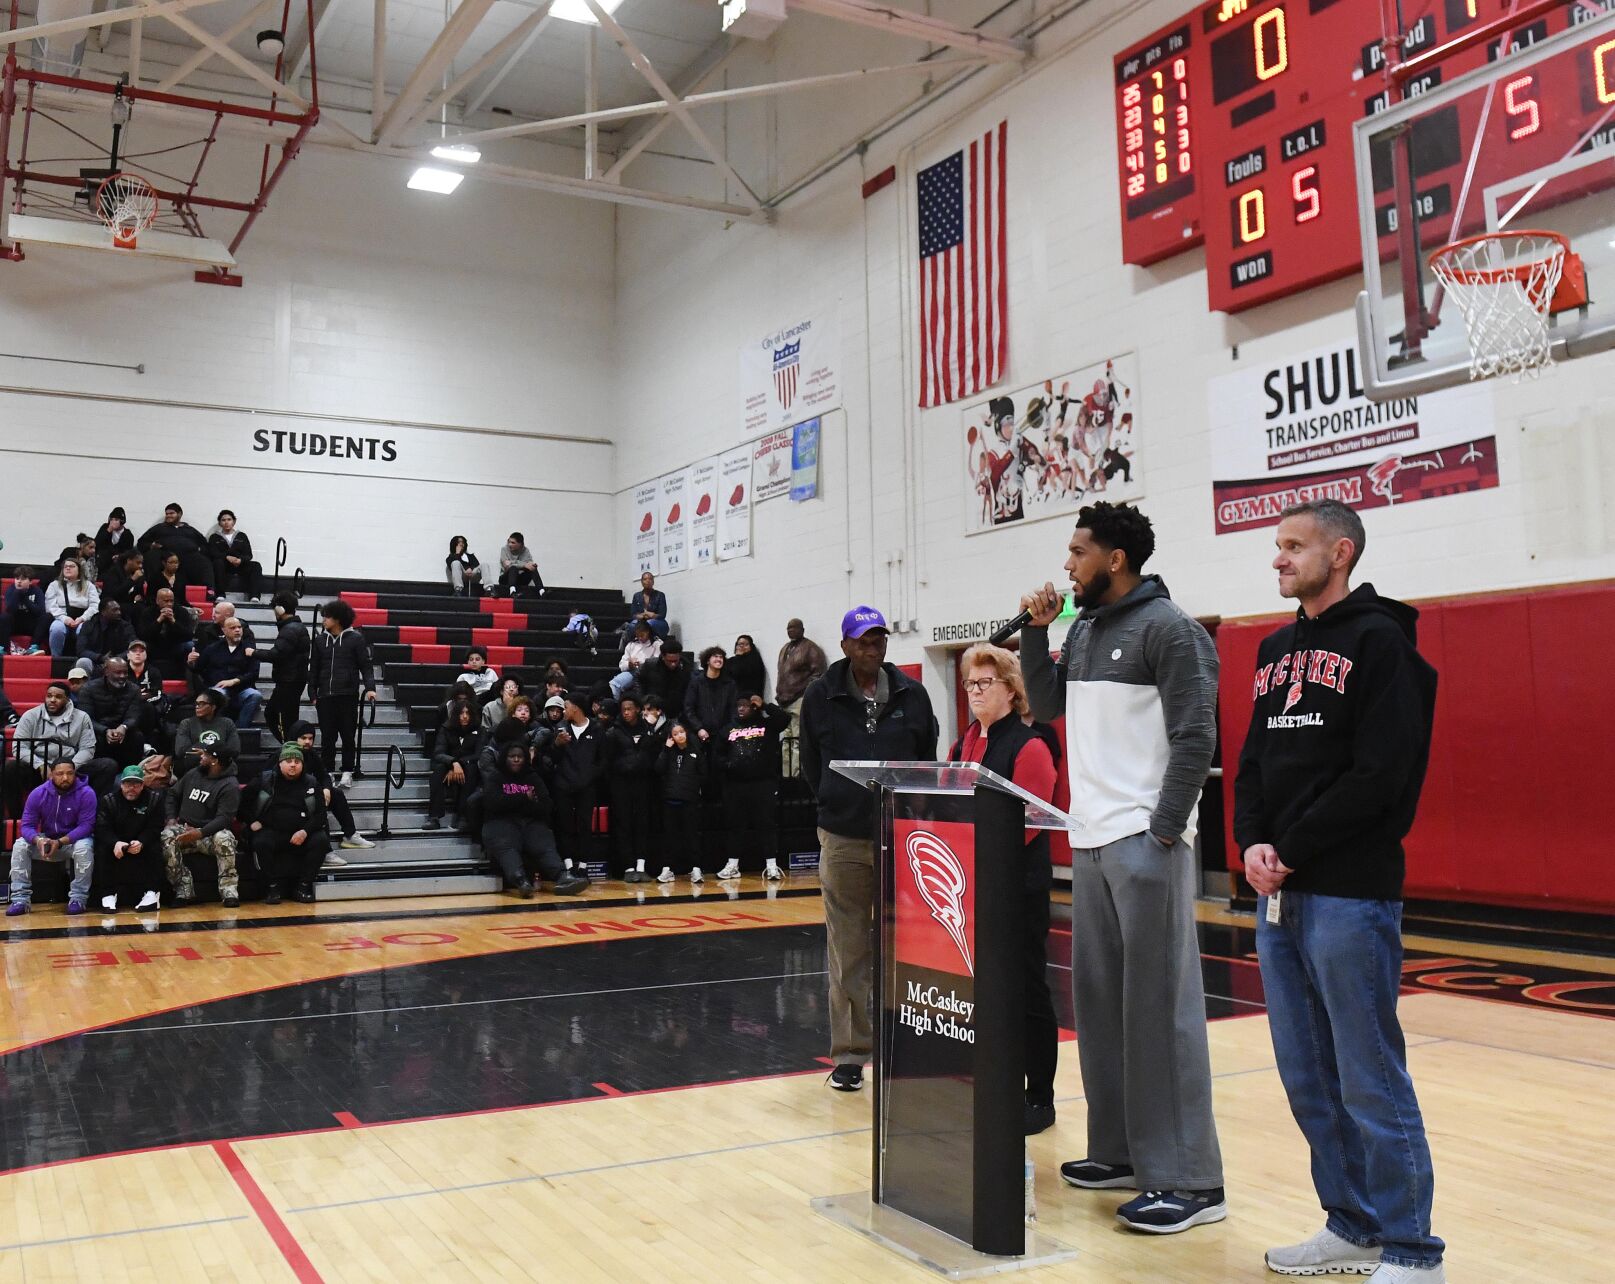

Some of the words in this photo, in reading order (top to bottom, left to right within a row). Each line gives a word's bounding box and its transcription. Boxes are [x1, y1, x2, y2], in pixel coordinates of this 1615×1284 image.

[1253, 7, 1288, 80] 0
[1174, 58, 1186, 80] 0
[1152, 93, 1164, 115] 0
[1153, 116, 1166, 135] 4
[1176, 104, 1188, 127] 3
[1504, 75, 1540, 140] 5
[1125, 150, 1145, 172] 41
[1154, 139, 1167, 161] 5
[1178, 128, 1190, 150] 3
[1178, 151, 1191, 173] 0
[1228, 153, 1263, 184] fouls
[1292, 166, 1321, 223] 5
[1239, 188, 1266, 243] 0
[1388, 195, 1434, 232] ge
[1236, 256, 1267, 282] won
[781, 320, 812, 342] Lancaster
[1263, 347, 1364, 420] SHUL
[1265, 396, 1419, 449] TRANSPORTATION
[253, 428, 397, 462] STUDENTS
[1270, 454, 1294, 468] School
[1294, 452, 1306, 463] Bus
[1334, 440, 1361, 454] Charter
[1362, 436, 1376, 449] Bus
[1376, 433, 1391, 445] and
[1391, 428, 1415, 442] Limos
[1218, 476, 1363, 526] GYMNASIUM
[932, 620, 987, 642] EMERGENCY
[323, 932, 459, 953] OF
[486, 912, 772, 940] HOME
[46, 943, 283, 969] THE
[906, 980, 975, 1024] McCaskey
[899, 1003, 933, 1037] High
[934, 1013, 975, 1044] Schoo
